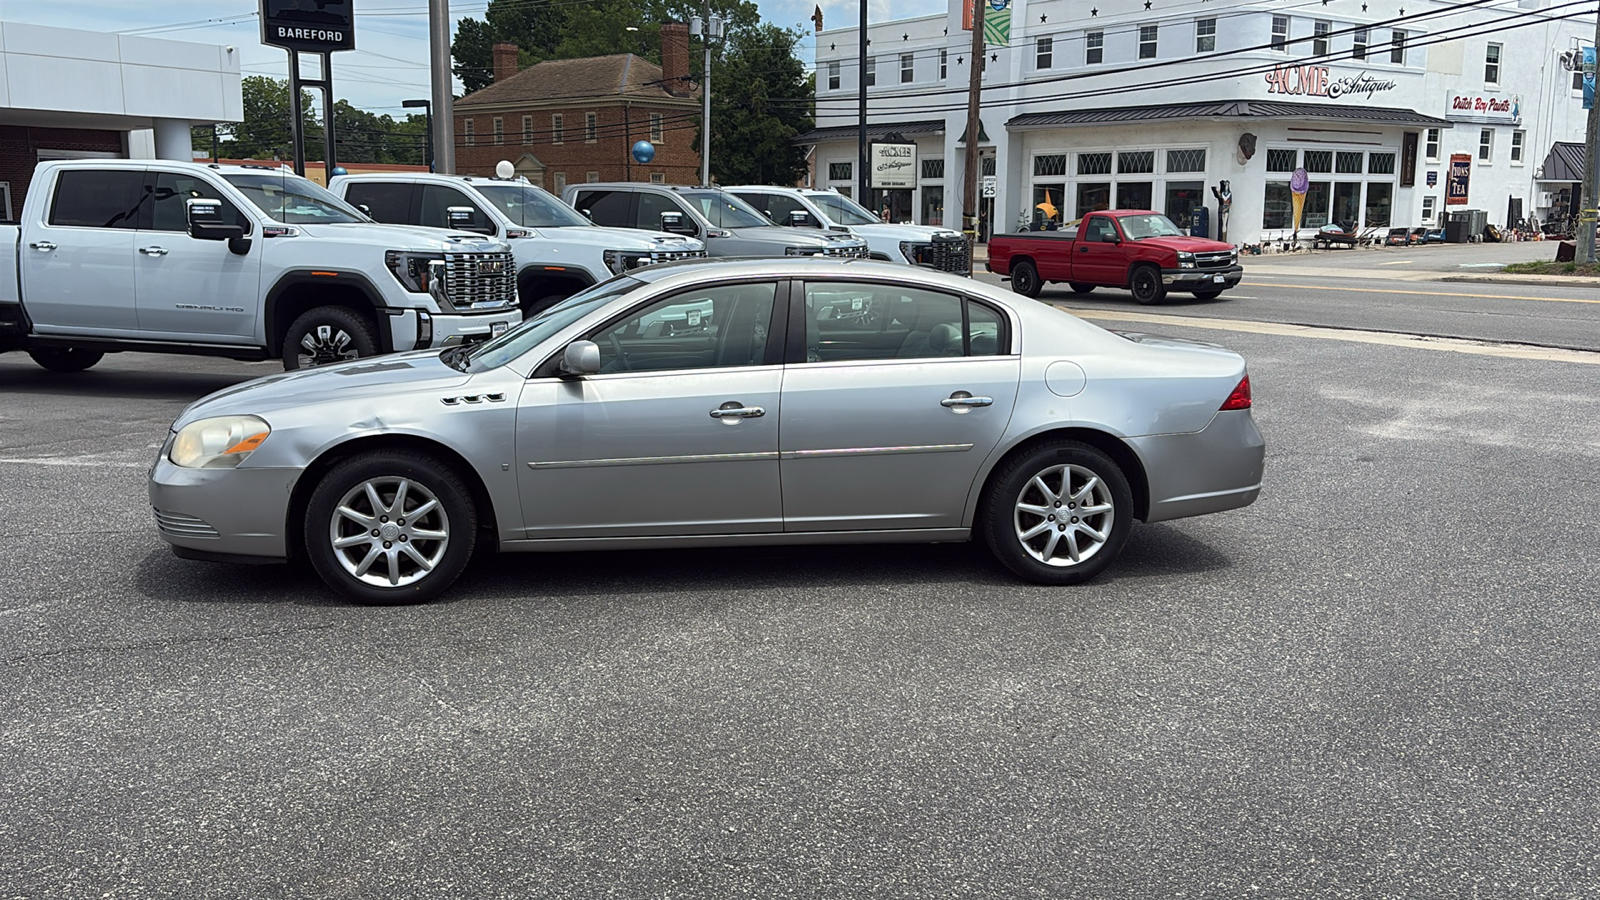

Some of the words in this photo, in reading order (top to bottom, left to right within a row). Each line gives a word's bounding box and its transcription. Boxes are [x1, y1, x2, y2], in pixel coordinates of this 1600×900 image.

[278, 27, 343, 42] BAREFORD
[1265, 64, 1329, 97] ACME
[1328, 70, 1397, 100] Antiques
[1453, 96, 1473, 110] Dutch
[1474, 97, 1488, 114] Boy
[1488, 98, 1510, 112] Paints
[879, 146, 912, 158] ACME
[984, 186, 996, 195] 25
[1452, 182, 1466, 195] TEA
